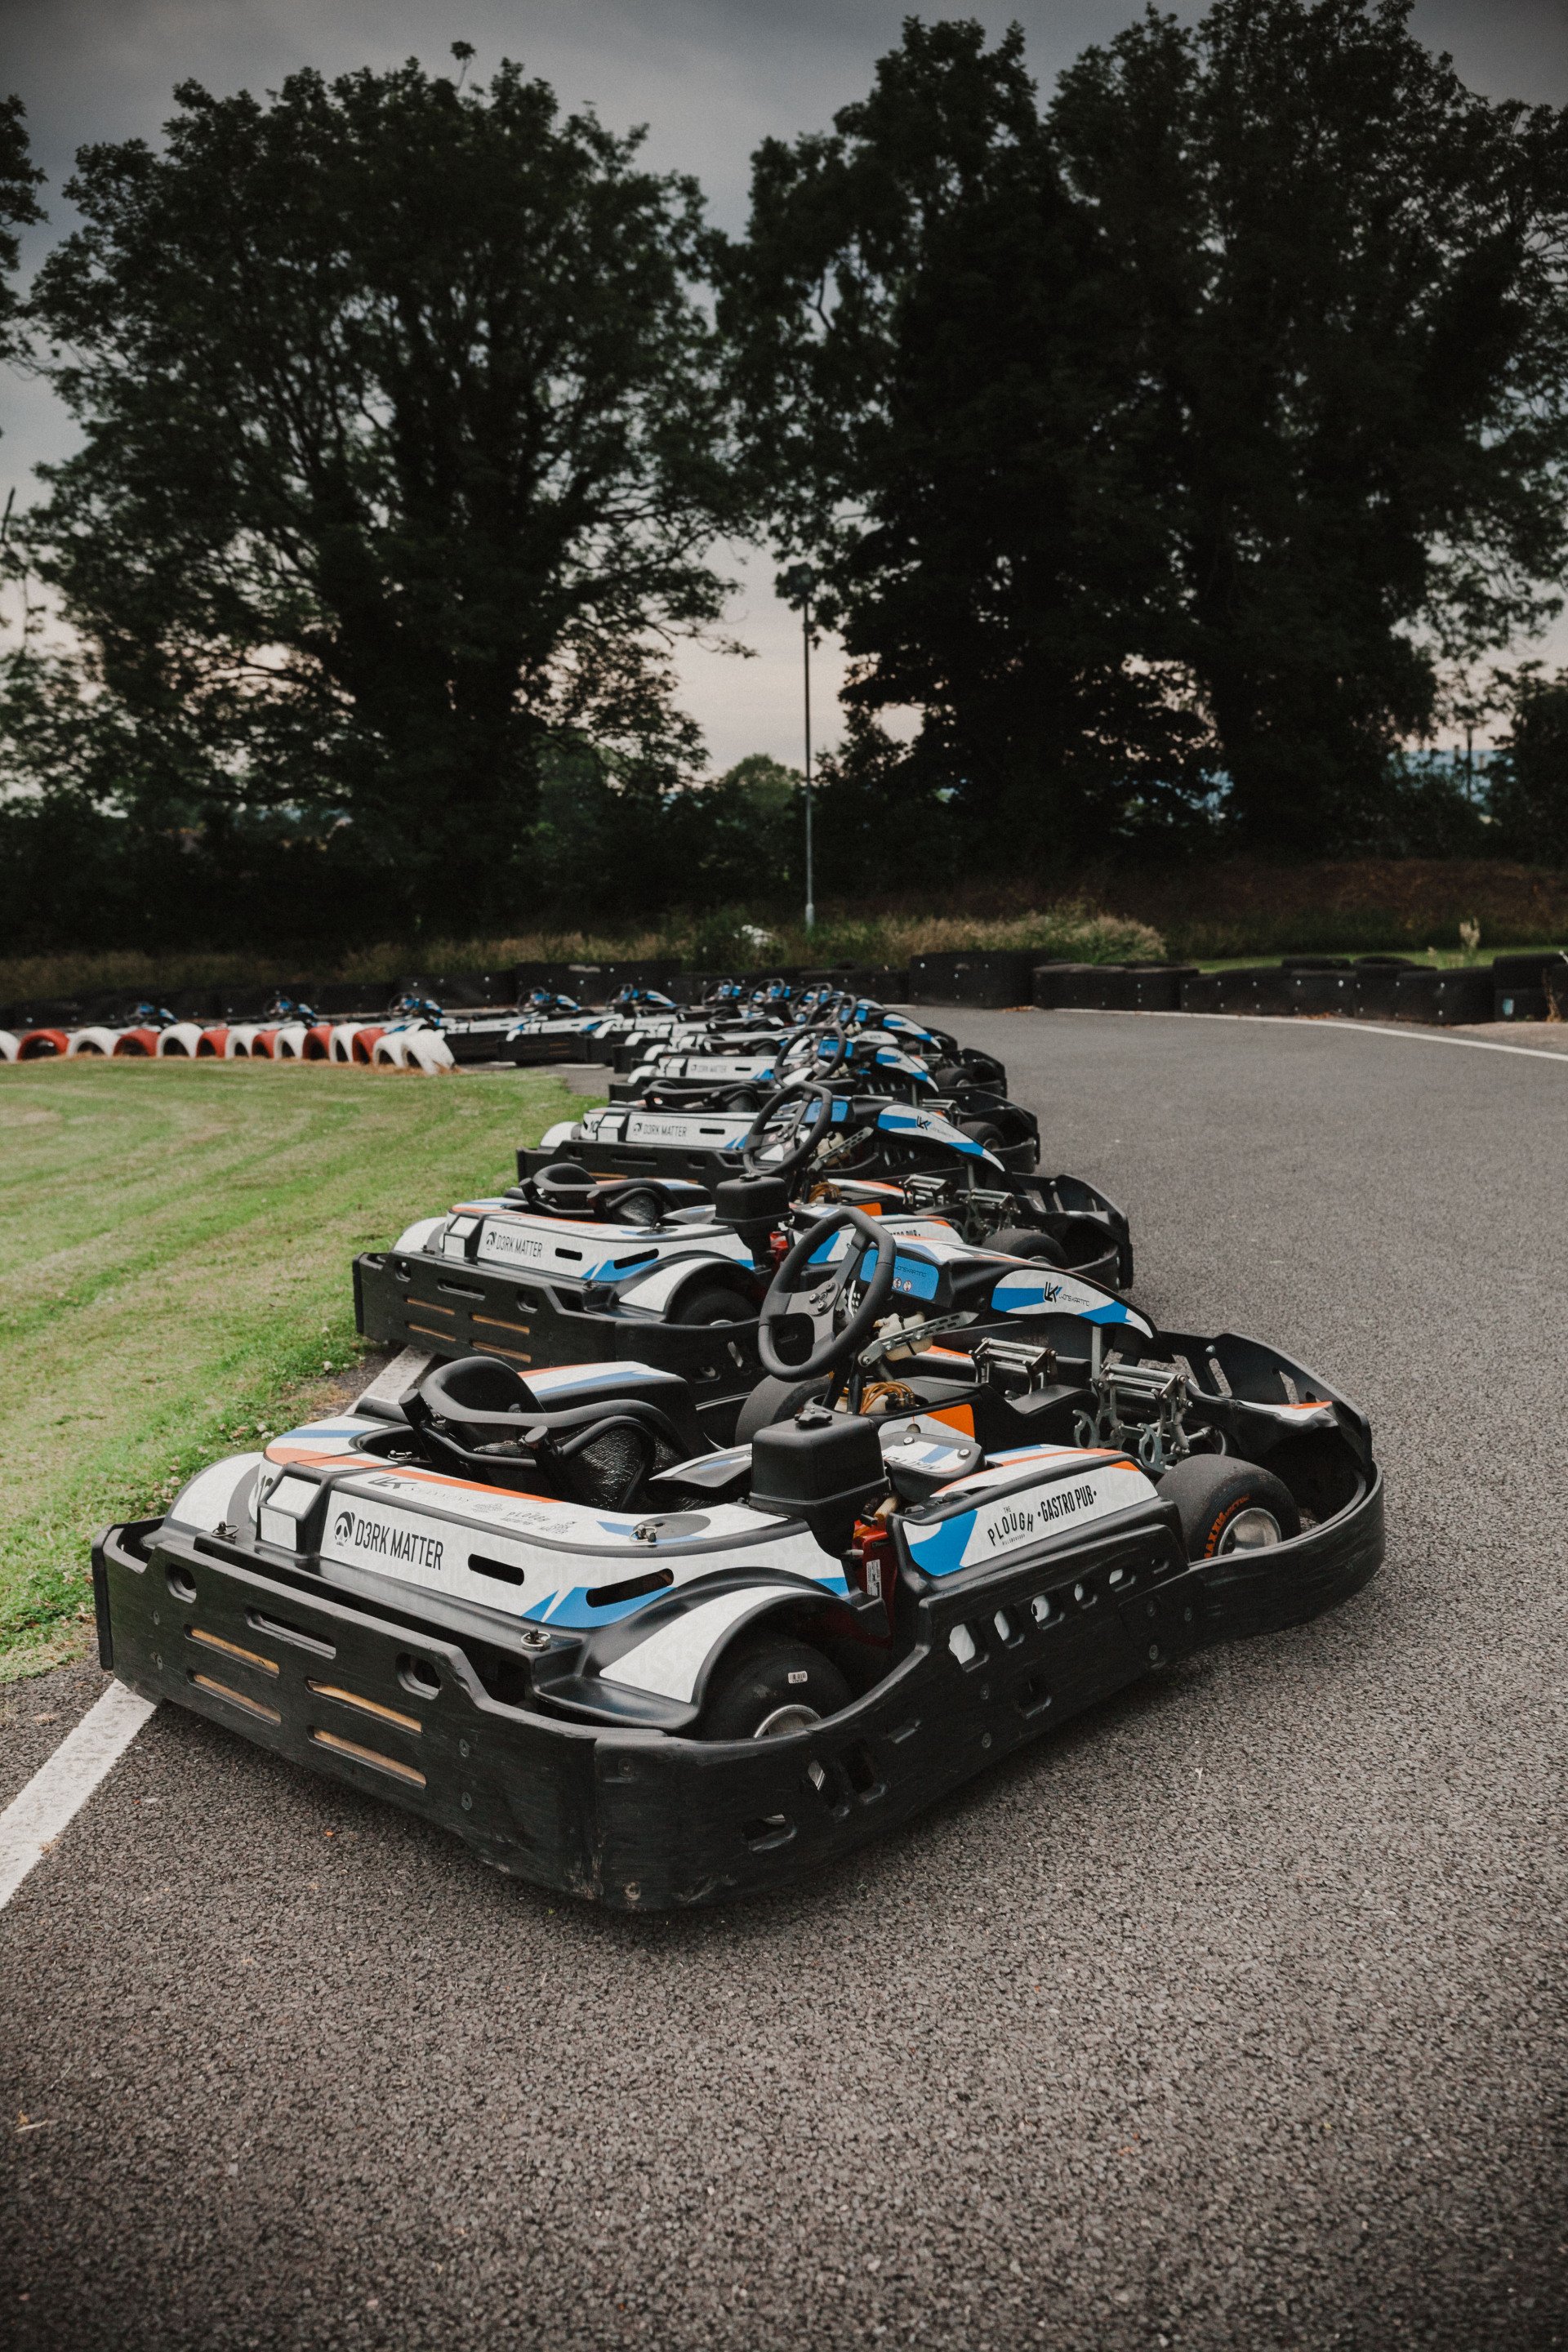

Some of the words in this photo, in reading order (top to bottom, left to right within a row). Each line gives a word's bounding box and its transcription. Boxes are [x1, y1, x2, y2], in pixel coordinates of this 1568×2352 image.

[497, 1235, 514, 1253] D3RK
[514, 1238, 543, 1258] MATTER
[354, 1519, 390, 1554] D3RK
[390, 1529, 444, 1570] MATTER
[987, 1512, 1033, 1546] PLOUGH
